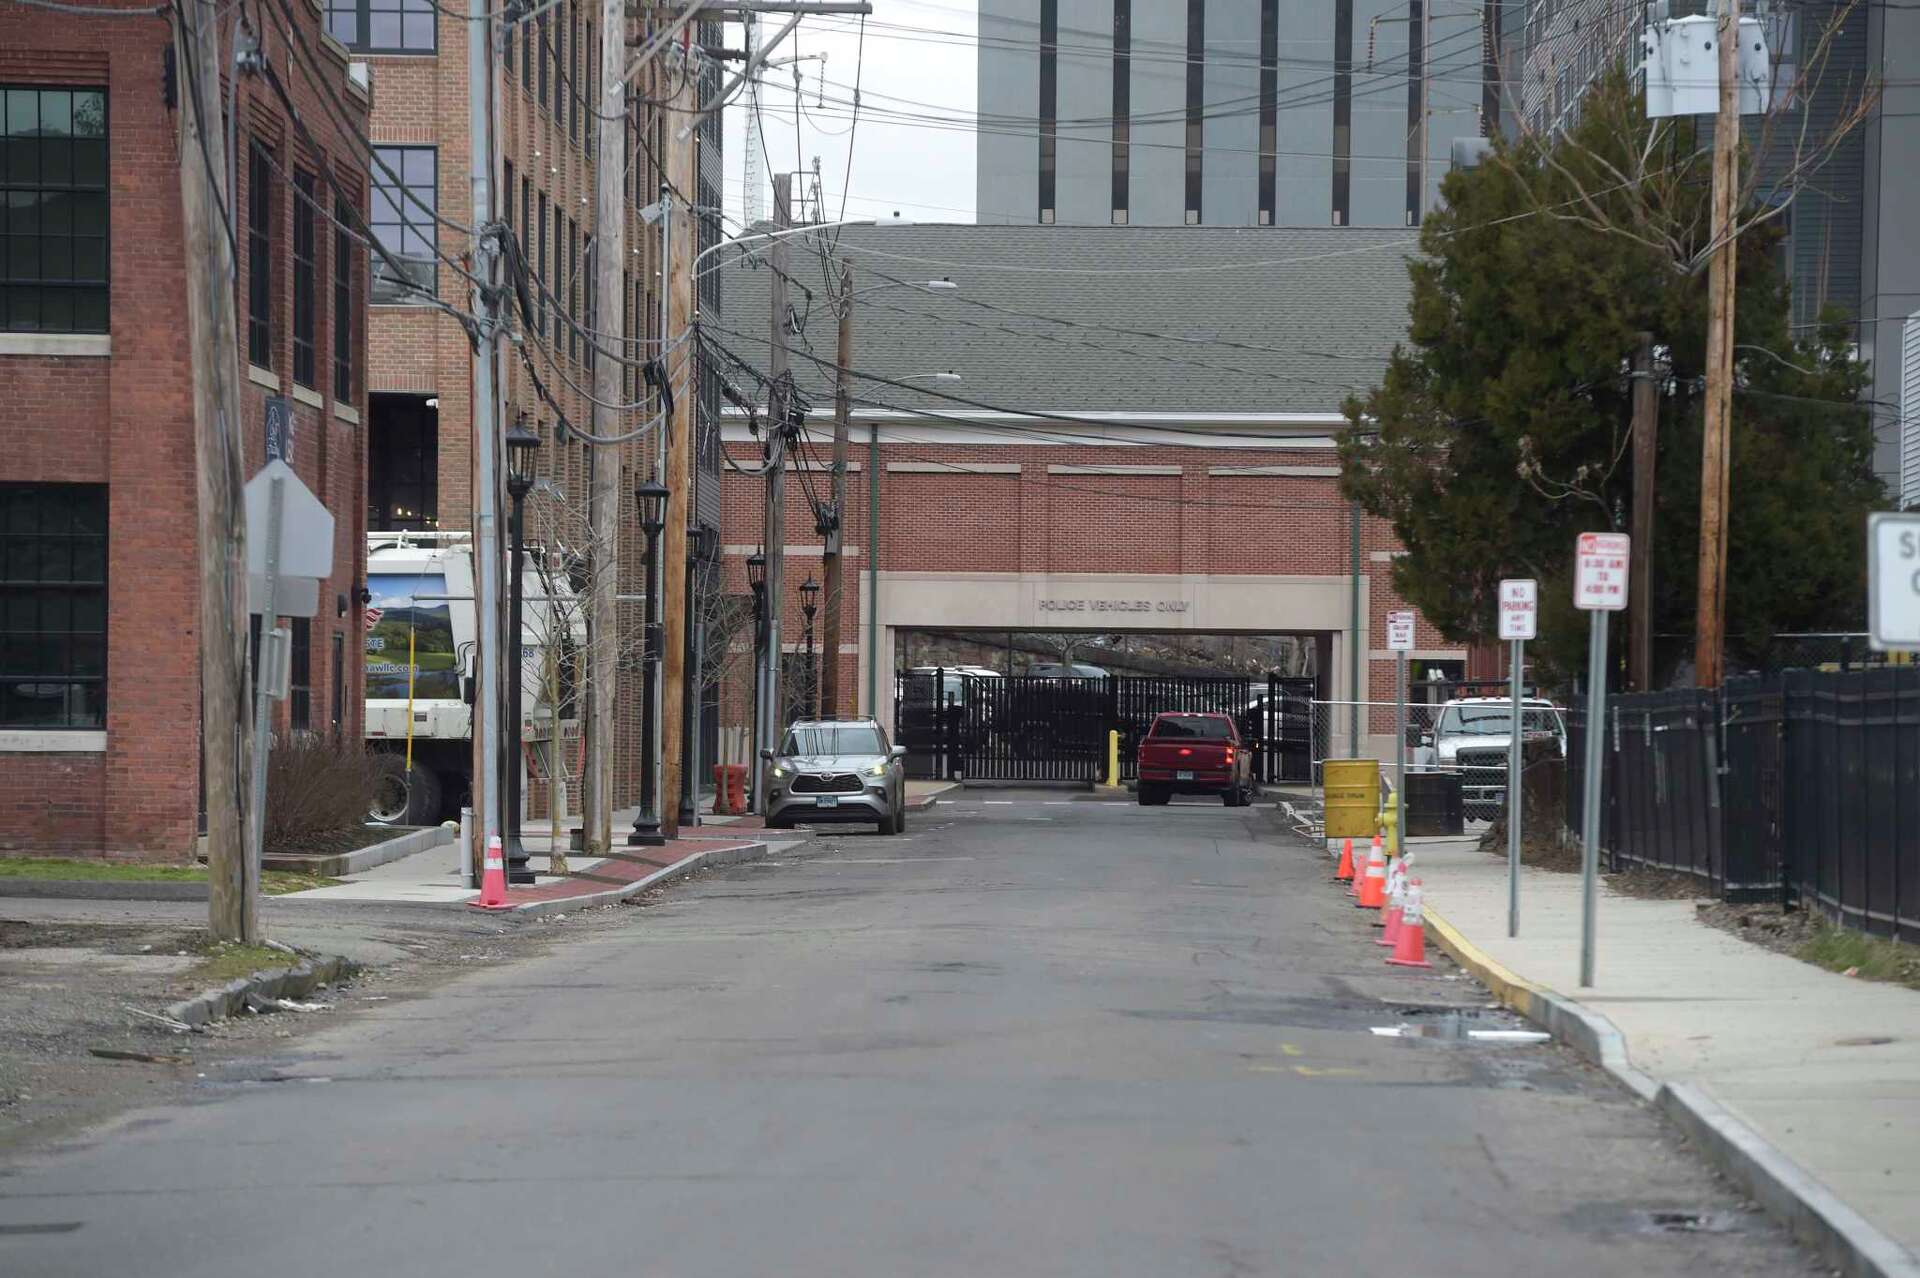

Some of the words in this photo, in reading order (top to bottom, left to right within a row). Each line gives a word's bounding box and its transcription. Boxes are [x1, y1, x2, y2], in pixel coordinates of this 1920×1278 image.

[1899, 530, 1920, 560] S
[1511, 587, 1526, 598] NO
[1038, 599, 1085, 611] POLICE
[1089, 599, 1152, 612] VEHICLES
[1156, 600, 1190, 612] ONLY
[1503, 600, 1534, 611] PARKING
